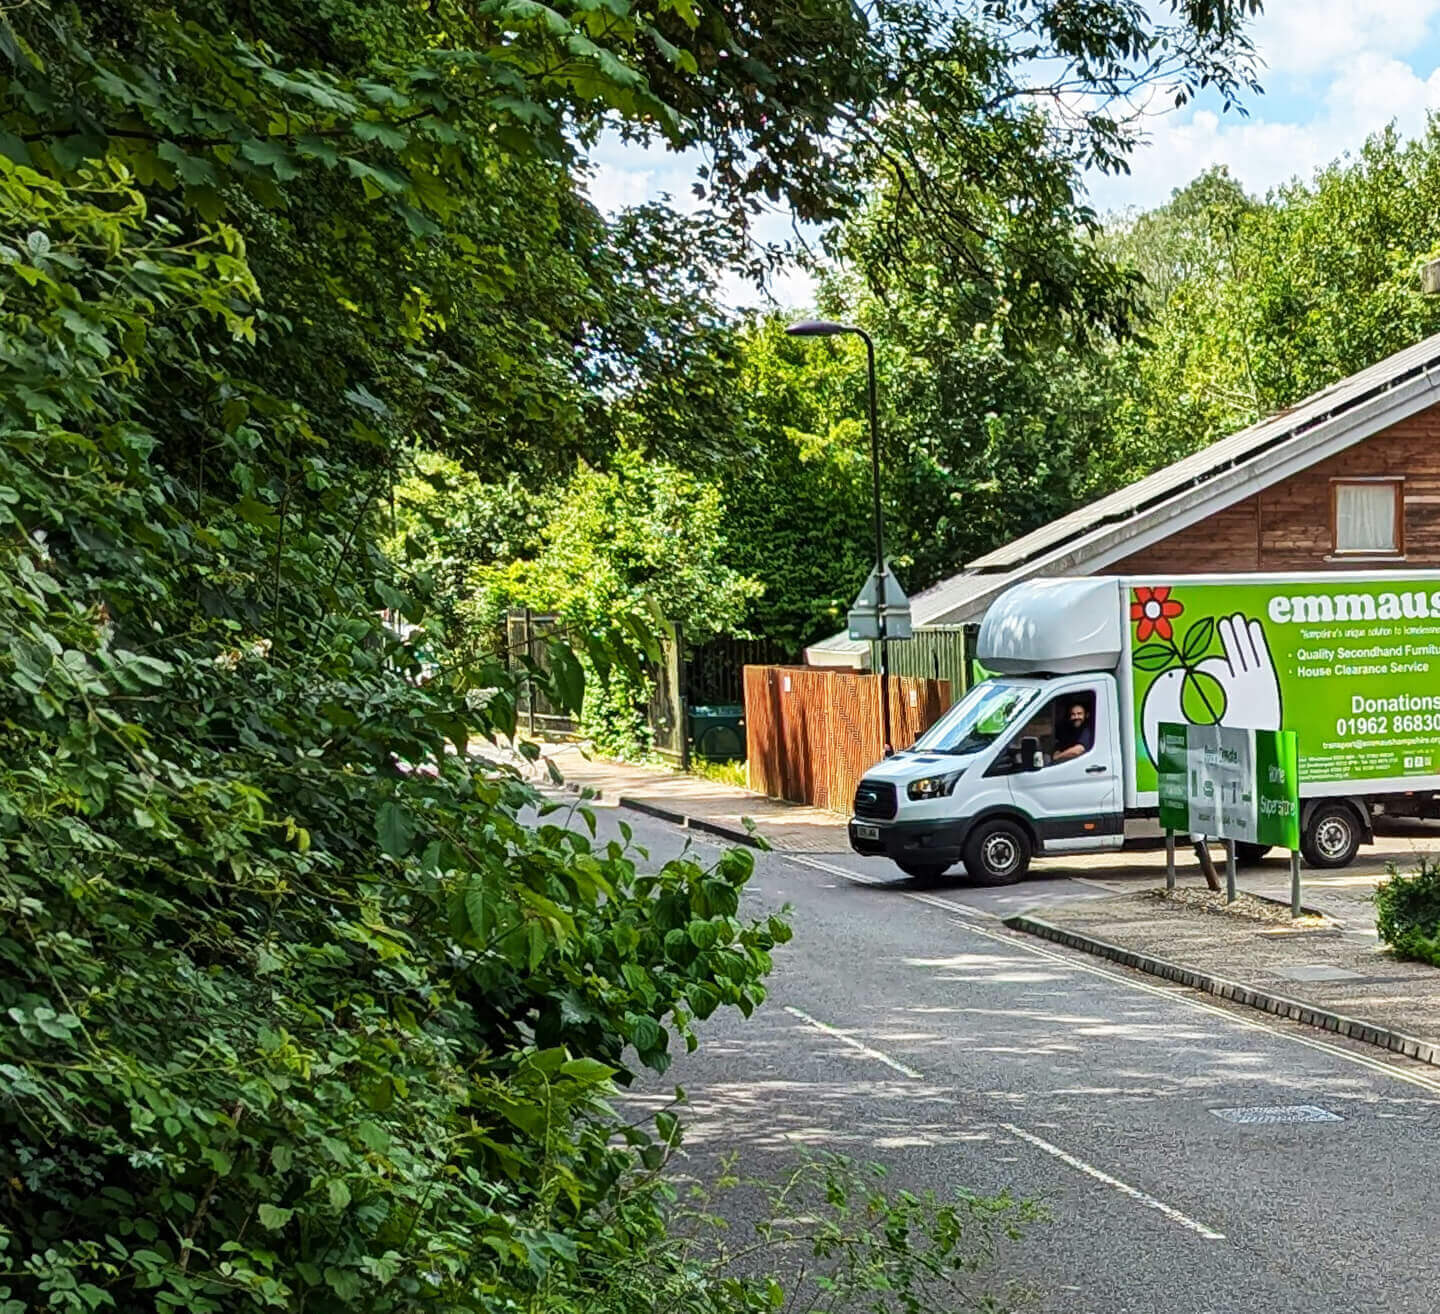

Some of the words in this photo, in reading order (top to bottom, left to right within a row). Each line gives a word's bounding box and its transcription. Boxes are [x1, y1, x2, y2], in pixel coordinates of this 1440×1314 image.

[1297, 648, 1335, 661] Quality
[1337, 646, 1403, 659] Secondhand
[1297, 664, 1332, 677] House
[1334, 662, 1388, 675] Clearance
[1391, 660, 1429, 673] Service
[1337, 716, 1388, 736] 01962
